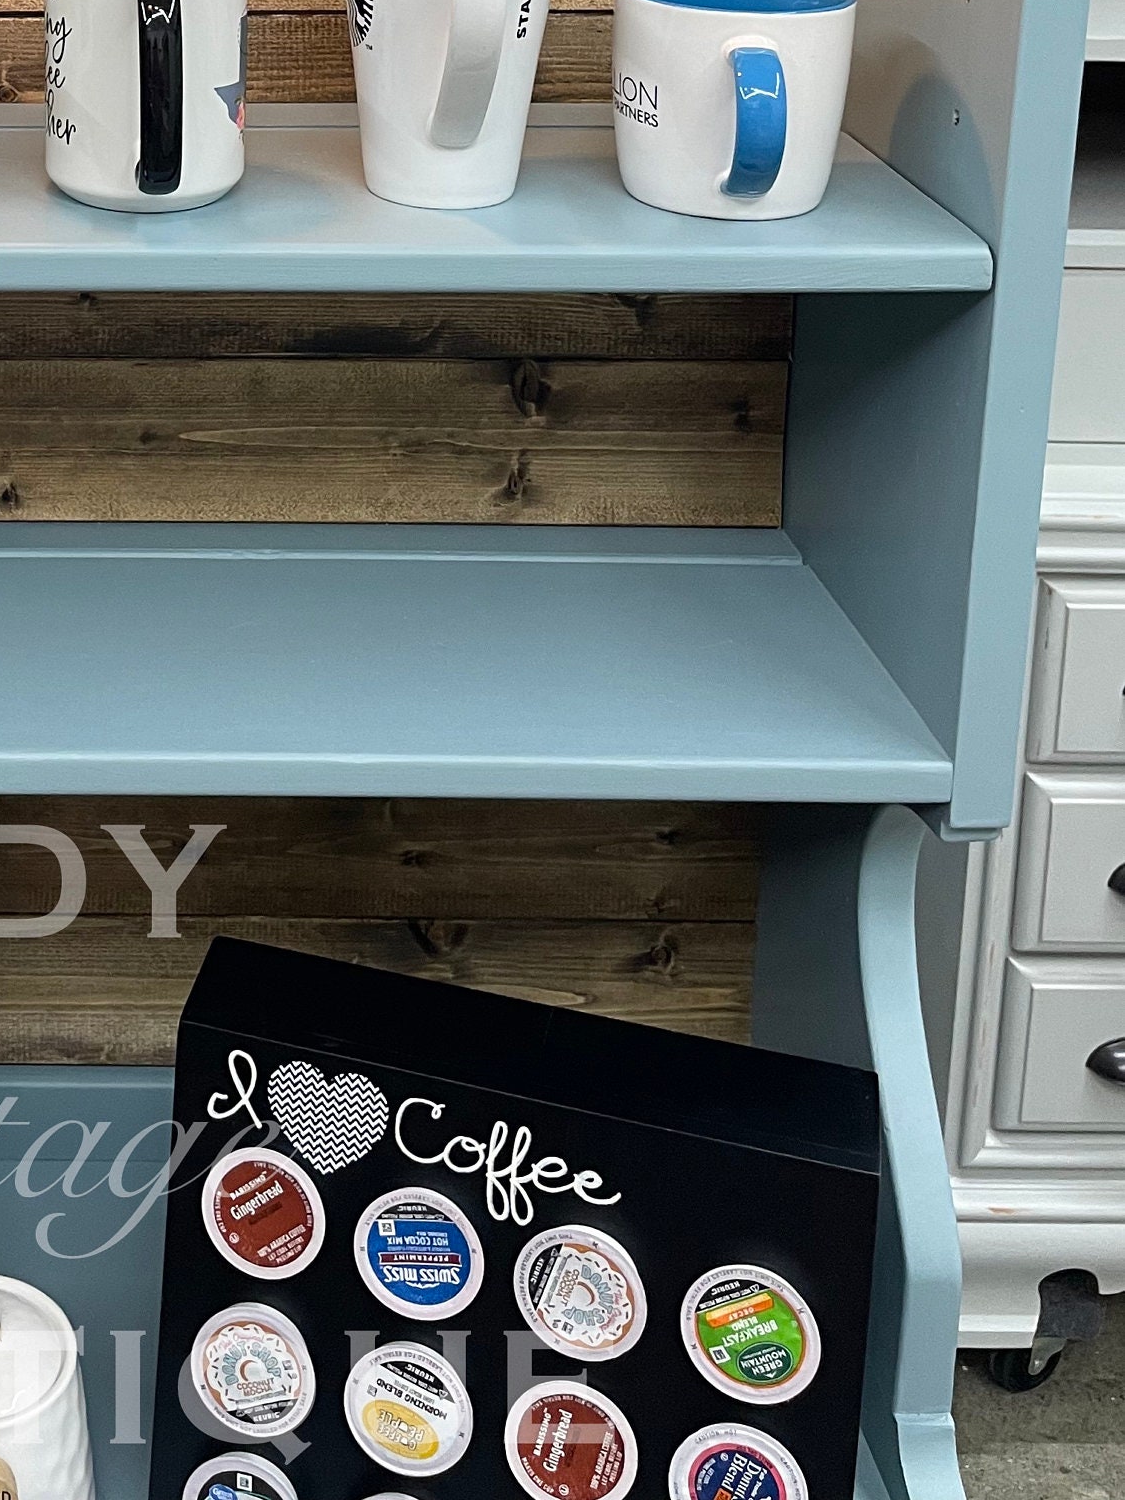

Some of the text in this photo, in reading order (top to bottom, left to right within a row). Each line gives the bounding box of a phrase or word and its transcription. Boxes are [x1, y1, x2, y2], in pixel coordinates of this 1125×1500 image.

[394, 1097, 622, 1227] Coffee
[229, 1179, 284, 1221] Gingerbread
[386, 1235, 449, 1246] HOT COCOA MIX
[393, 1254, 449, 1263] PEPPERMINT
[383, 1265, 461, 1285] SWISS MISS
[562, 1264, 614, 1327] DONUT SHOP
[711, 1280, 741, 1296] KEURIG
[728, 1306, 755, 1321] DECAF
[731, 1316, 759, 1331] BLEND
[721, 1319, 779, 1347] BREAKFAST
[221, 1340, 282, 1386] DONUT SHOP
[739, 1349, 788, 1369] MOUNTAIN
[751, 1359, 783, 1377] GREEN
[404, 1363, 436, 1383] KEURIG
[236, 1376, 275, 1391] COCONUT
[243, 1384, 273, 1397] MOCHA
[376, 1378, 403, 1398] BLEND
[404, 1393, 448, 1420] MORNING
[533, 1412, 552, 1457] BARISSIMO
[542, 1408, 573, 1472] Gingerbread
[720, 1452, 748, 1492] Blend
